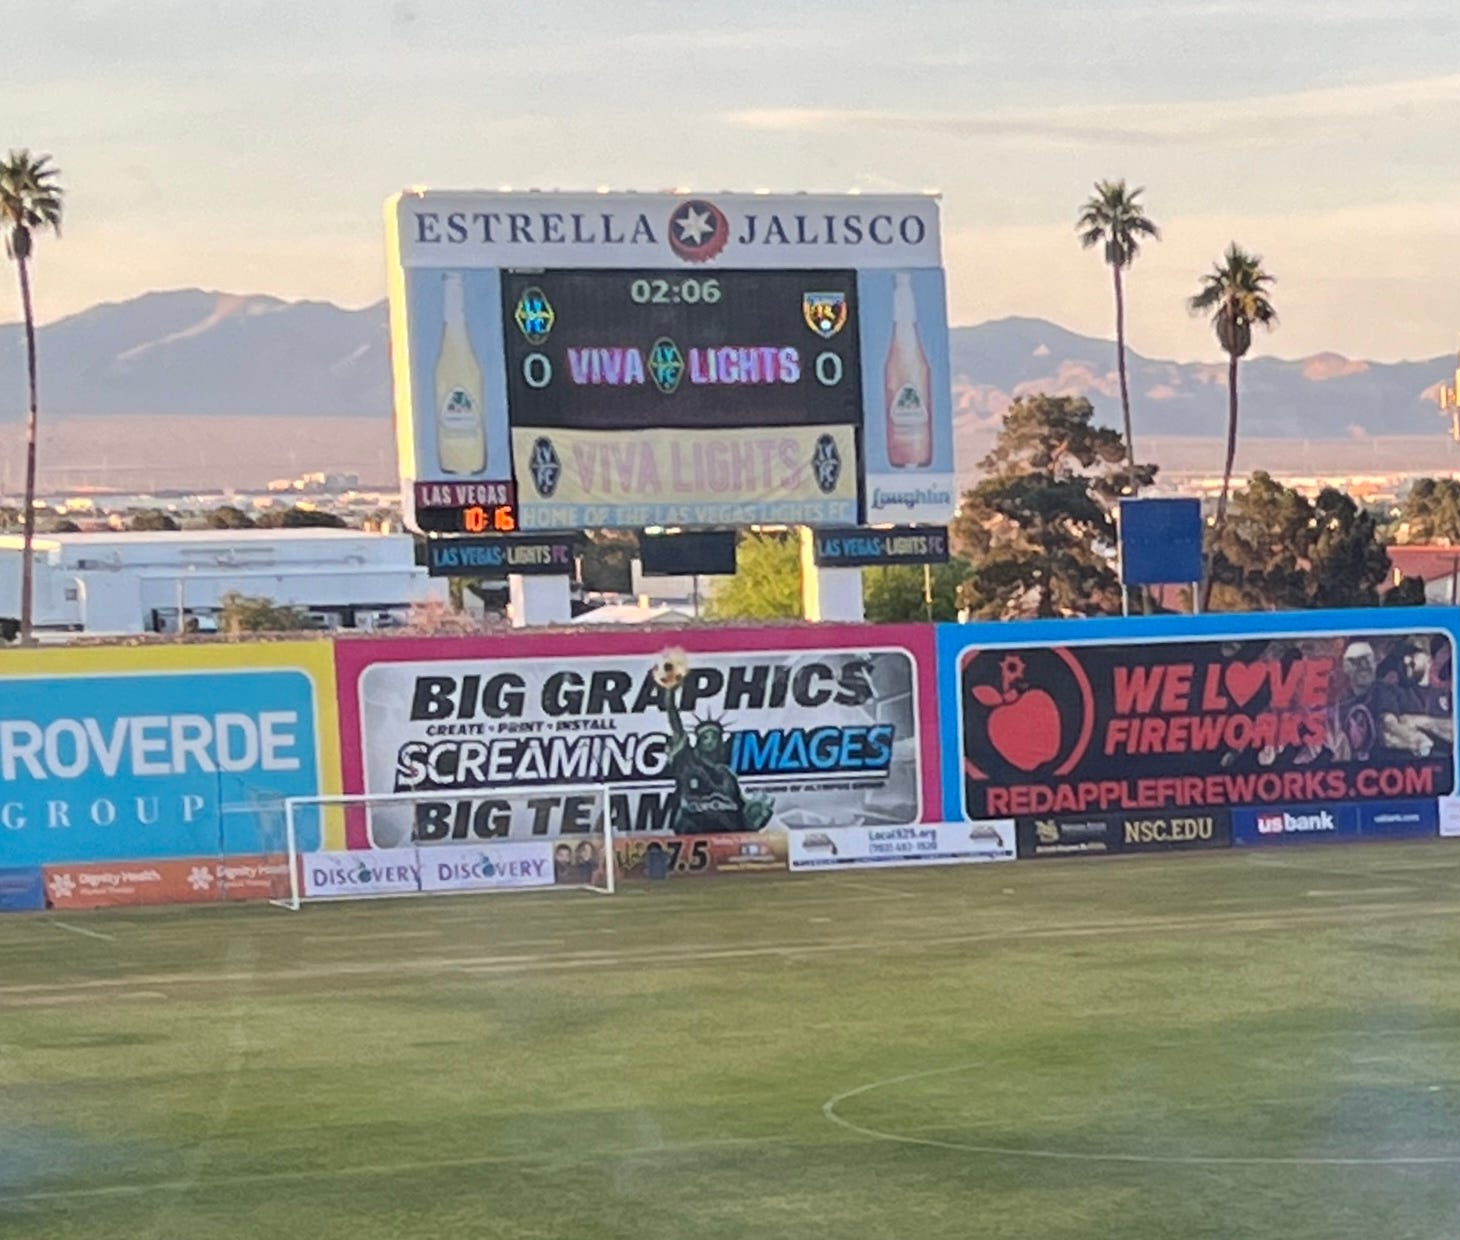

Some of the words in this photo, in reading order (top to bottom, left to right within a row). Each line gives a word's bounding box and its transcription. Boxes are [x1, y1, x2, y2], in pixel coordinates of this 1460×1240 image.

[414, 212, 659, 244] ESTRELLA
[738, 214, 926, 245] JALISCO
[630, 279, 721, 304] 02:06
[523, 353, 552, 388] 0
[566, 347, 645, 385] VIVA
[688, 347, 801, 385] LIGHTS
[815, 352, 843, 386] 0
[572, 440, 662, 494] VIVA
[671, 438, 802, 493] LIGHTS
[422, 485, 452, 505] LAS
[456, 484, 507, 504] VEGAS
[522, 507, 579, 526] HOME
[654, 504, 690, 524] LAS
[694, 504, 756, 523] VEGAS
[434, 547, 459, 566] LAS
[460, 547, 501, 566] VEGAS
[507, 546, 551, 565] LIGHTS
[551, 546, 569, 564] FC
[818, 540, 841, 557] LAS
[842, 539, 881, 557] VEGAS
[885, 537, 927, 555] LIGHTS
[928, 537, 945, 554] FC
[410, 673, 526, 721] BIG
[541, 661, 876, 718] GRAPHICS
[1113, 662, 1195, 715] WE
[426, 724, 484, 737] CREATE
[497, 722, 544, 734] PRINT
[556, 719, 617, 731] INSTALL
[1104, 711, 1328, 756] FIREWORKS
[1, 711, 300, 781] ROVERDE
[397, 734, 670, 786] SCREAMING
[730, 726, 893, 771] IMAGES
[986, 766, 1434, 816] REDAPPLEFIREWORKS.COM
[1, 795, 205, 830] GROUP
[415, 799, 512, 842] BIG
[1124, 817, 1213, 844] NSC.EDU
[79, 872, 121, 886] Dignity
[438, 858, 547, 882] DISCOVERY
